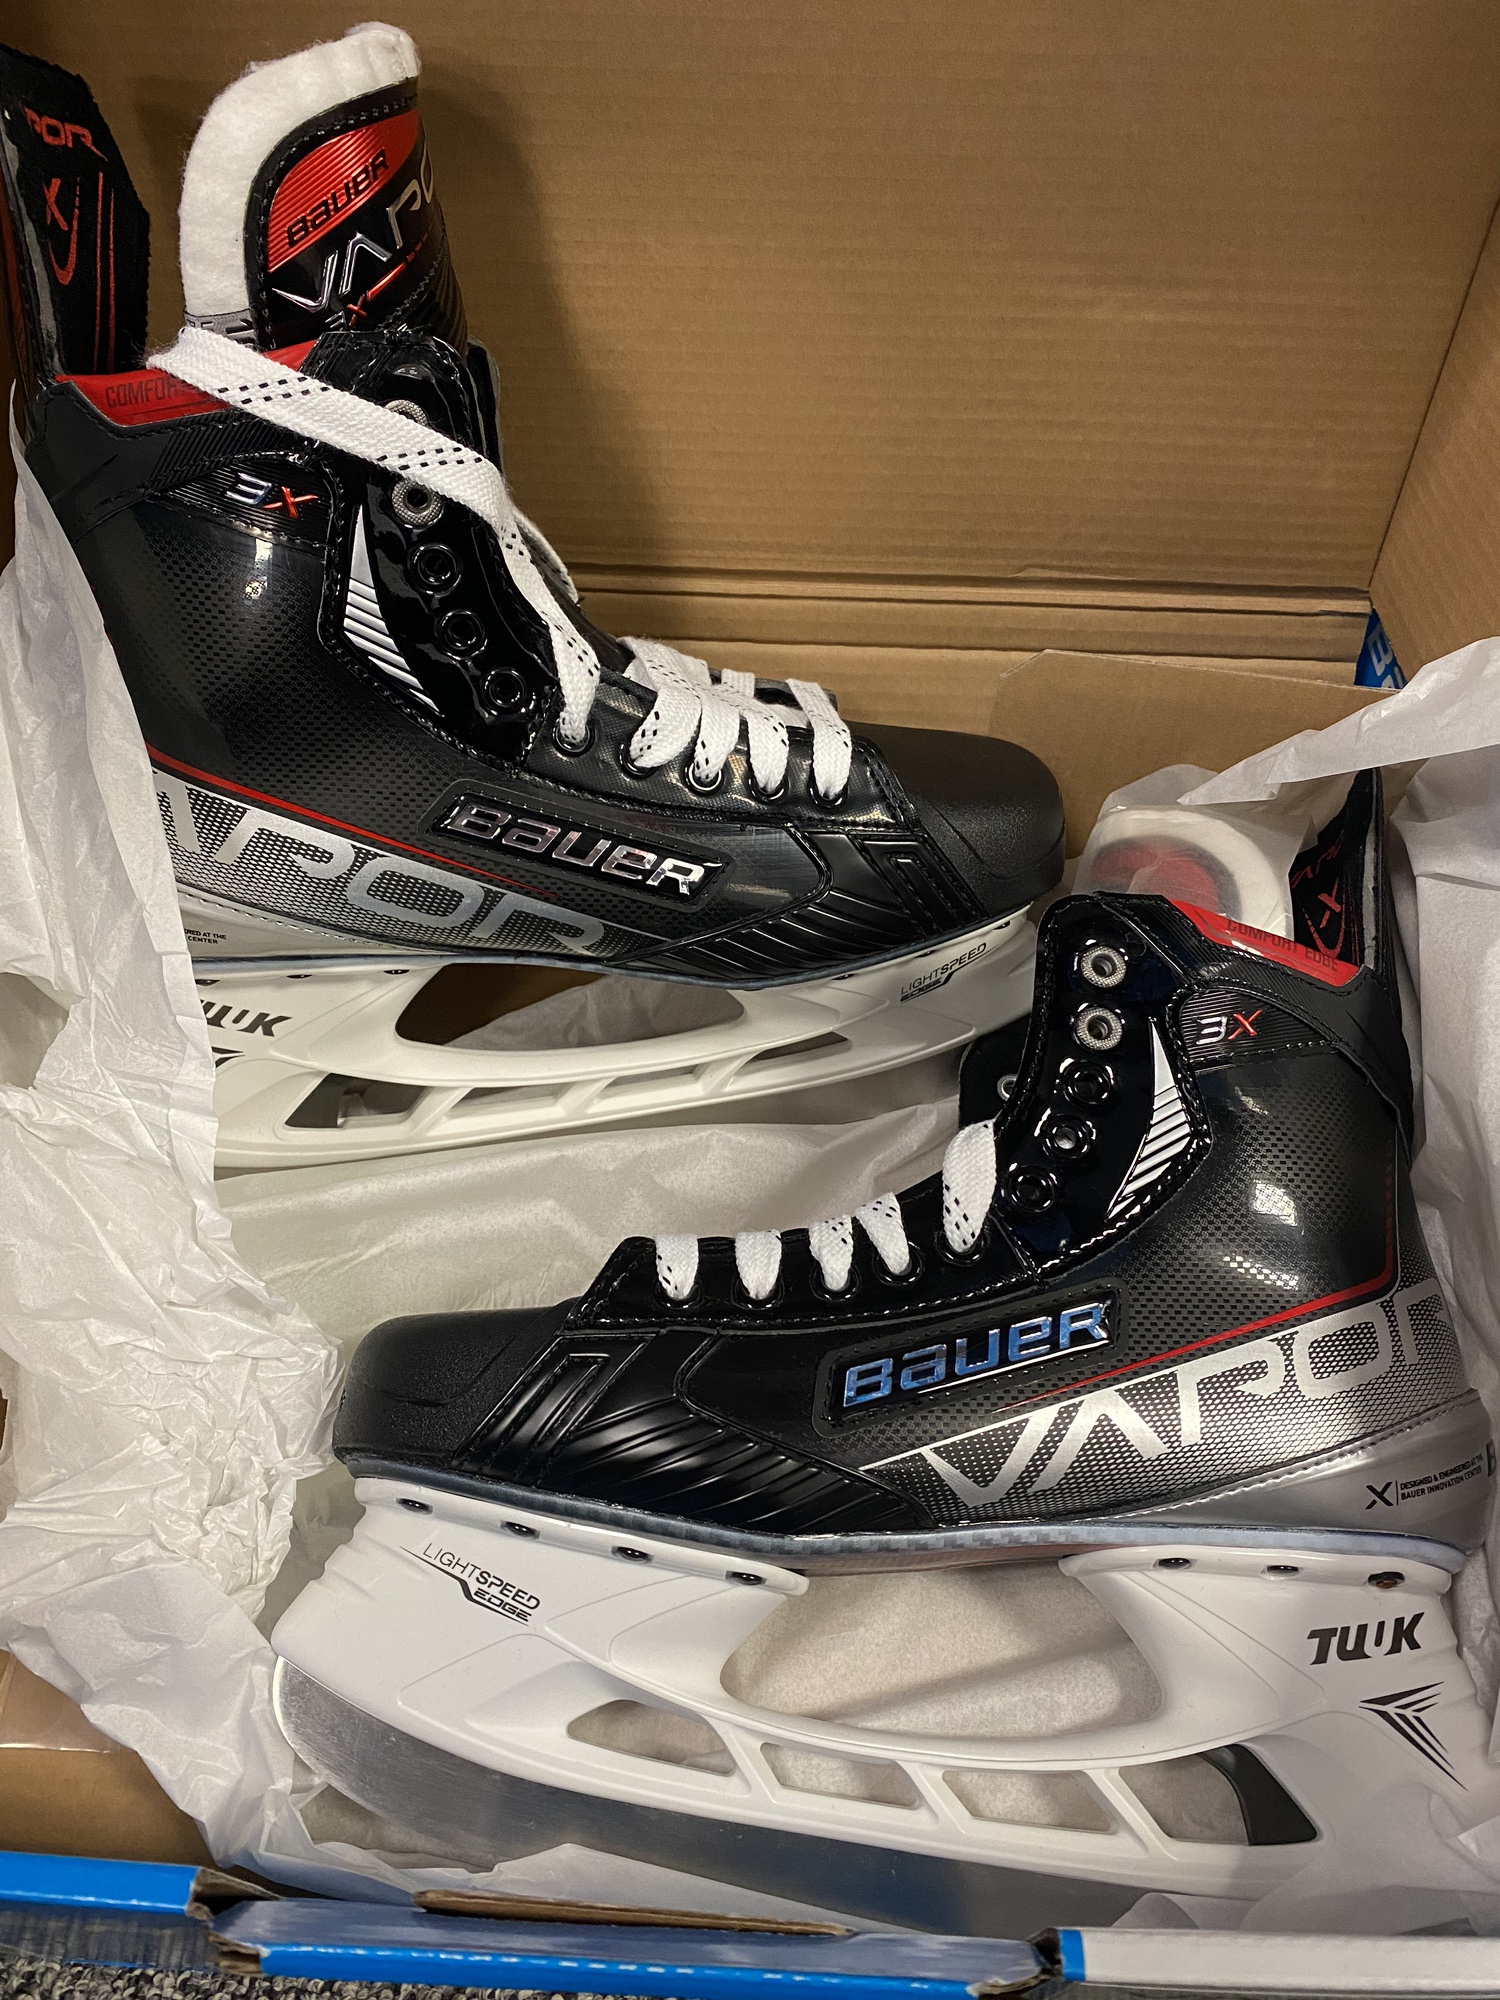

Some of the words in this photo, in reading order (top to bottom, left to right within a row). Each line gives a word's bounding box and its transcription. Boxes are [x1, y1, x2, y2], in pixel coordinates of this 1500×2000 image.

[187, 935, 218, 945] CENTER
[901, 942, 987, 995] LIGHTSPEED
[1400, 1475, 1433, 1491] DESIGNED
[1400, 1488, 1427, 1500] BAUER
[1427, 1475, 1465, 1494] INNOVATION
[422, 1543, 541, 1610] LIGHTSPEED
[473, 1587, 532, 1622] EDGE
